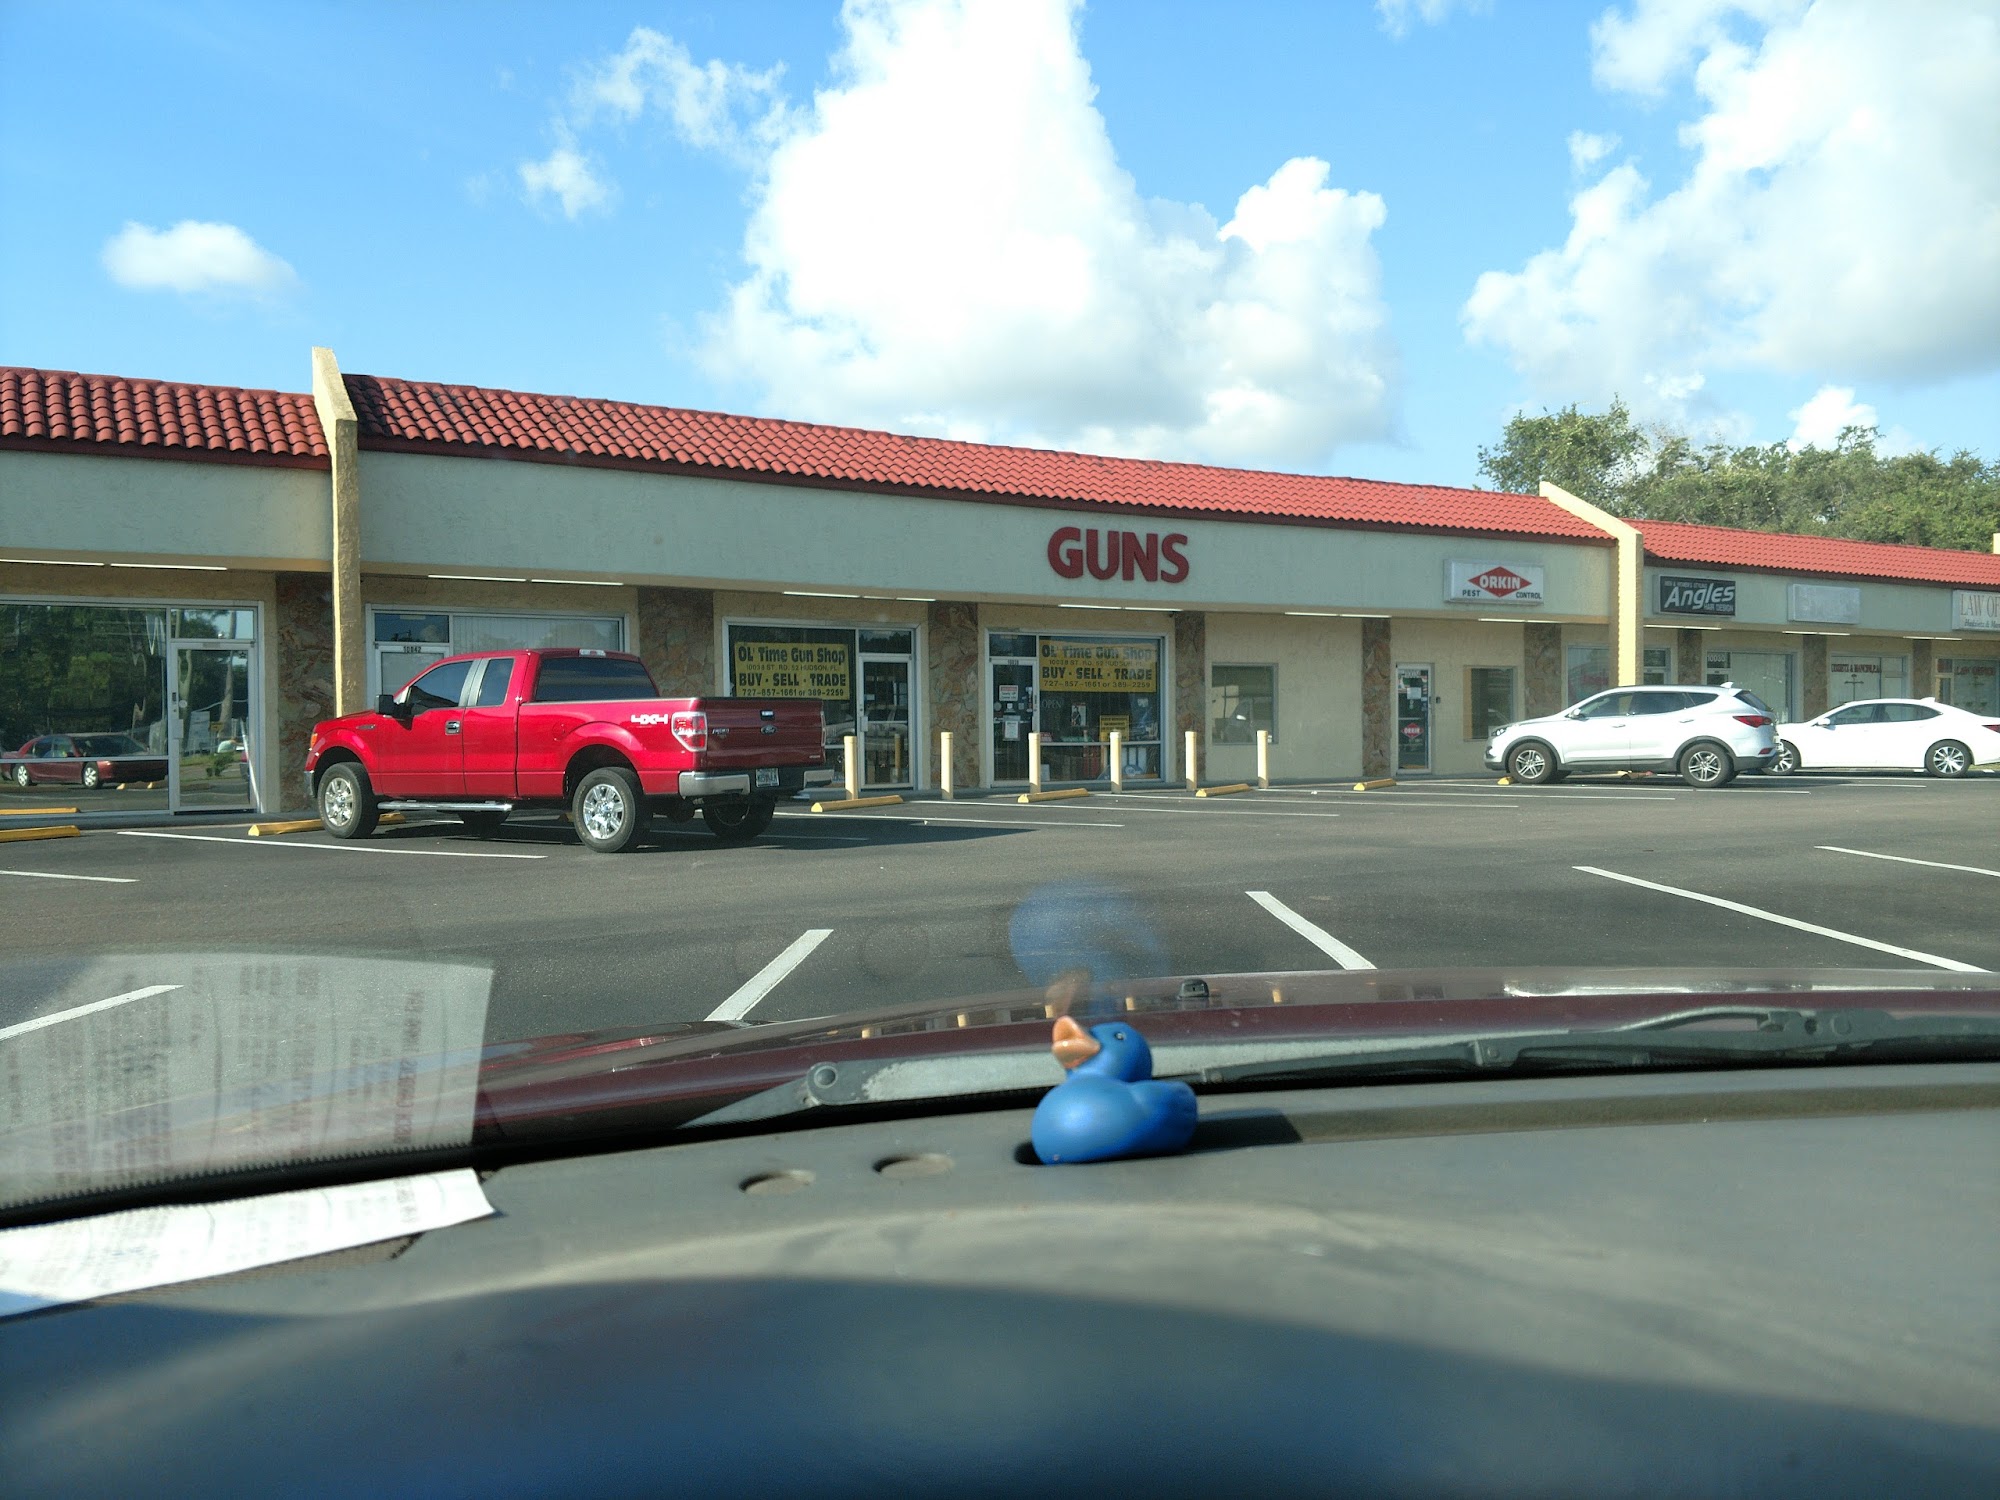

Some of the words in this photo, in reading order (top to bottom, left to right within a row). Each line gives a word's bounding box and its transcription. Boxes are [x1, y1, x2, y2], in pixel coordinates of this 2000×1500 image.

[1047, 527, 1190, 583] GUNS
[1480, 575, 1520, 590] ORKIN
[1462, 589, 1480, 597] PEST
[1516, 591, 1542, 600] CONTROL
[1664, 583, 1736, 610] Angles
[1961, 593, 1985, 616] LAW
[758, 646, 788, 662] Time
[791, 647, 814, 663] Gun
[817, 647, 845, 665] Shop
[1062, 645, 1092, 659] Time
[1095, 646, 1119, 659] Gun
[1123, 647, 1152, 661] Shop
[739, 672, 763, 686] BUY
[772, 673, 800, 686] SELL
[809, 673, 846, 687] TRADE
[1042, 666, 1066, 679] BUY
[1076, 667, 1103, 680] SELL
[1114, 668, 1152, 680] TRADE
[742, 688, 797, 696] 727-857-1661
[1042, 699, 1062, 709] OPEN
